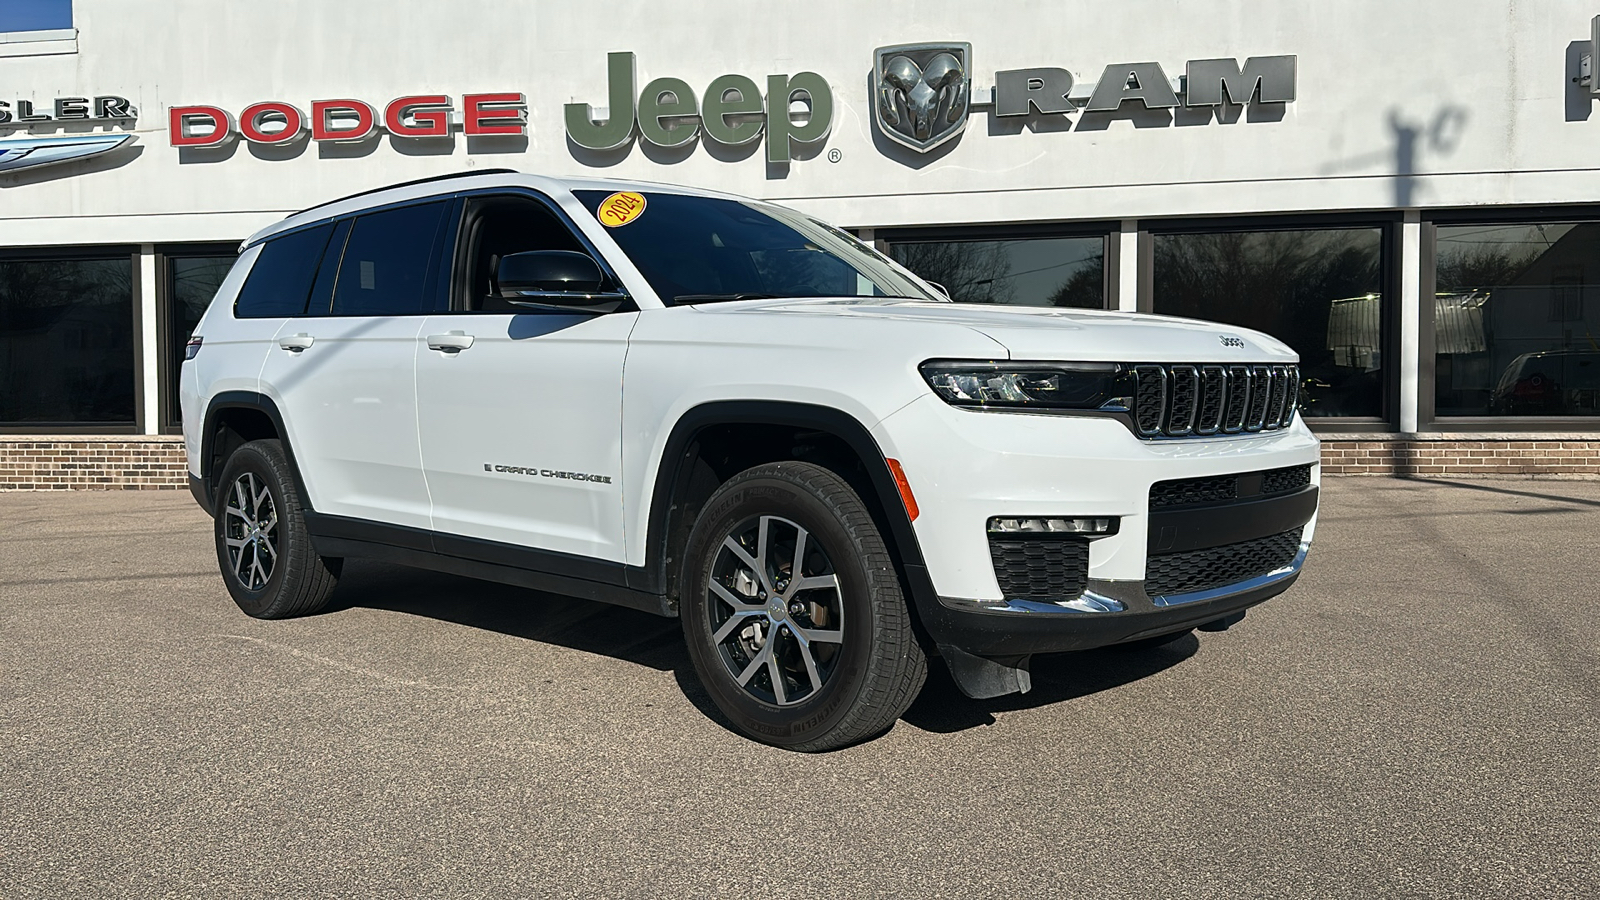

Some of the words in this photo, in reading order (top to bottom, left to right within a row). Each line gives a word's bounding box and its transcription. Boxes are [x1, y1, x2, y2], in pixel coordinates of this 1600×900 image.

[995, 55, 1298, 117] RAM
[0, 96, 131, 122] LER
[168, 92, 527, 149] DODGE
[564, 51, 834, 163] Jeep
[606, 194, 641, 222] 2024
[1219, 335, 1245, 349] Jeep
[494, 464, 538, 476] GRAND
[540, 469, 612, 484] CHEROKEE
[701, 492, 742, 534] MICHELIN
